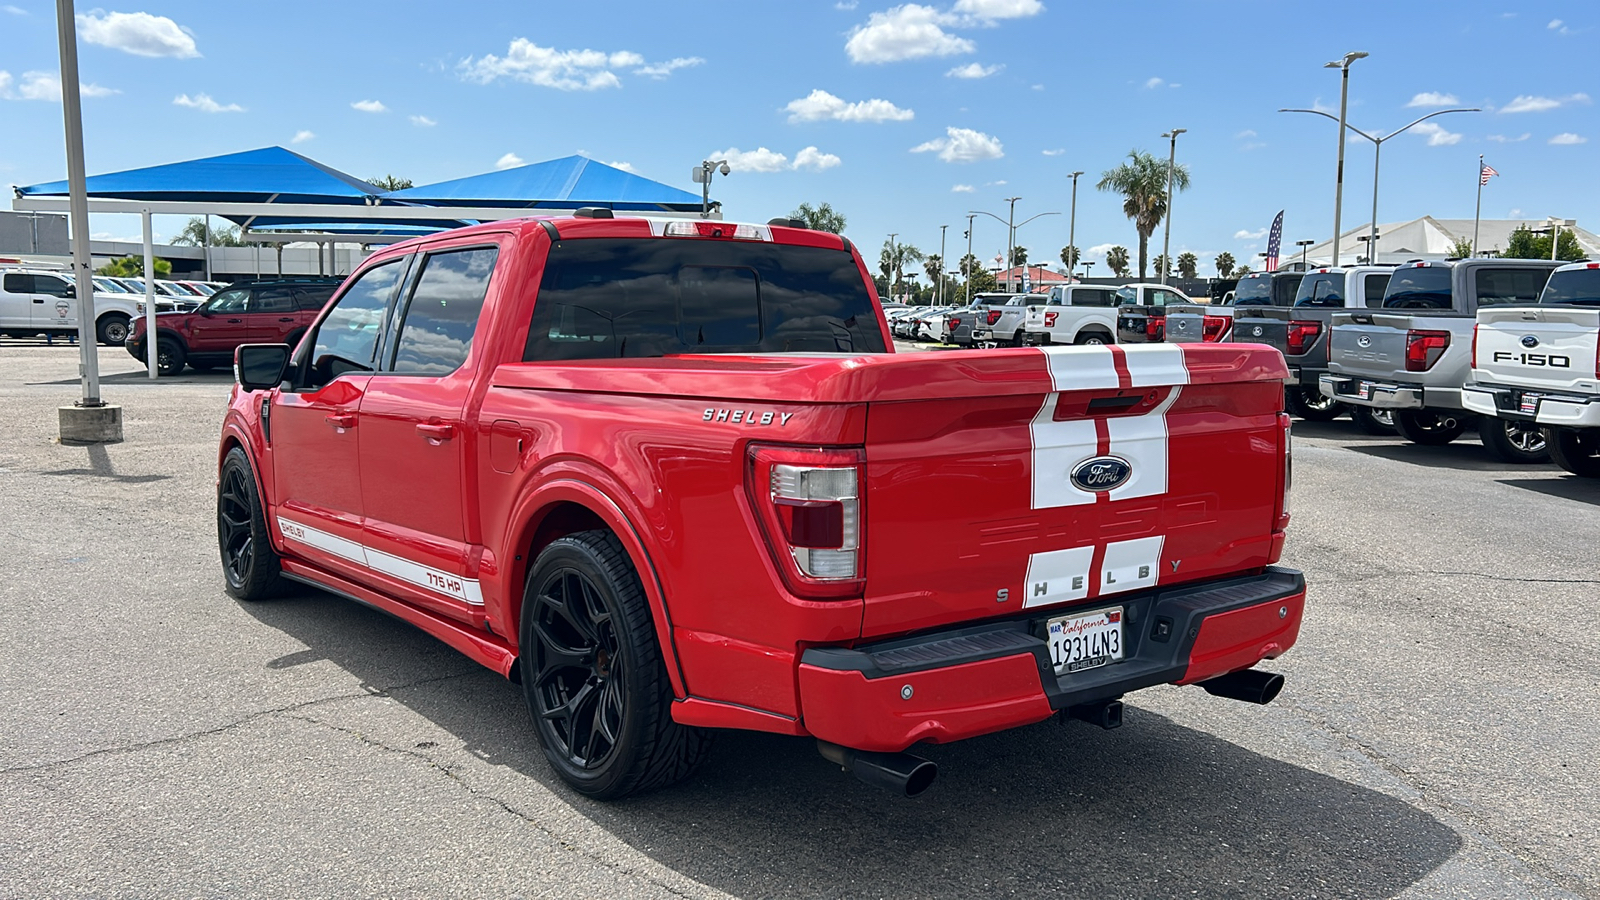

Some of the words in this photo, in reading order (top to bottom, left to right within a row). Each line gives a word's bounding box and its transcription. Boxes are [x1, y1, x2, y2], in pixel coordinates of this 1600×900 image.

[1493, 351, 1570, 368] F-150
[702, 408, 793, 426] SHELBY
[1087, 464, 1120, 484] Ford
[280, 522, 305, 539] SHELBY
[426, 572, 446, 588] 775
[446, 579, 461, 592] HP
[1050, 625, 1061, 634] MAR
[1062, 619, 1109, 635] California
[1053, 629, 1119, 667] 19314N3
[1070, 657, 1105, 671] SHELBY
